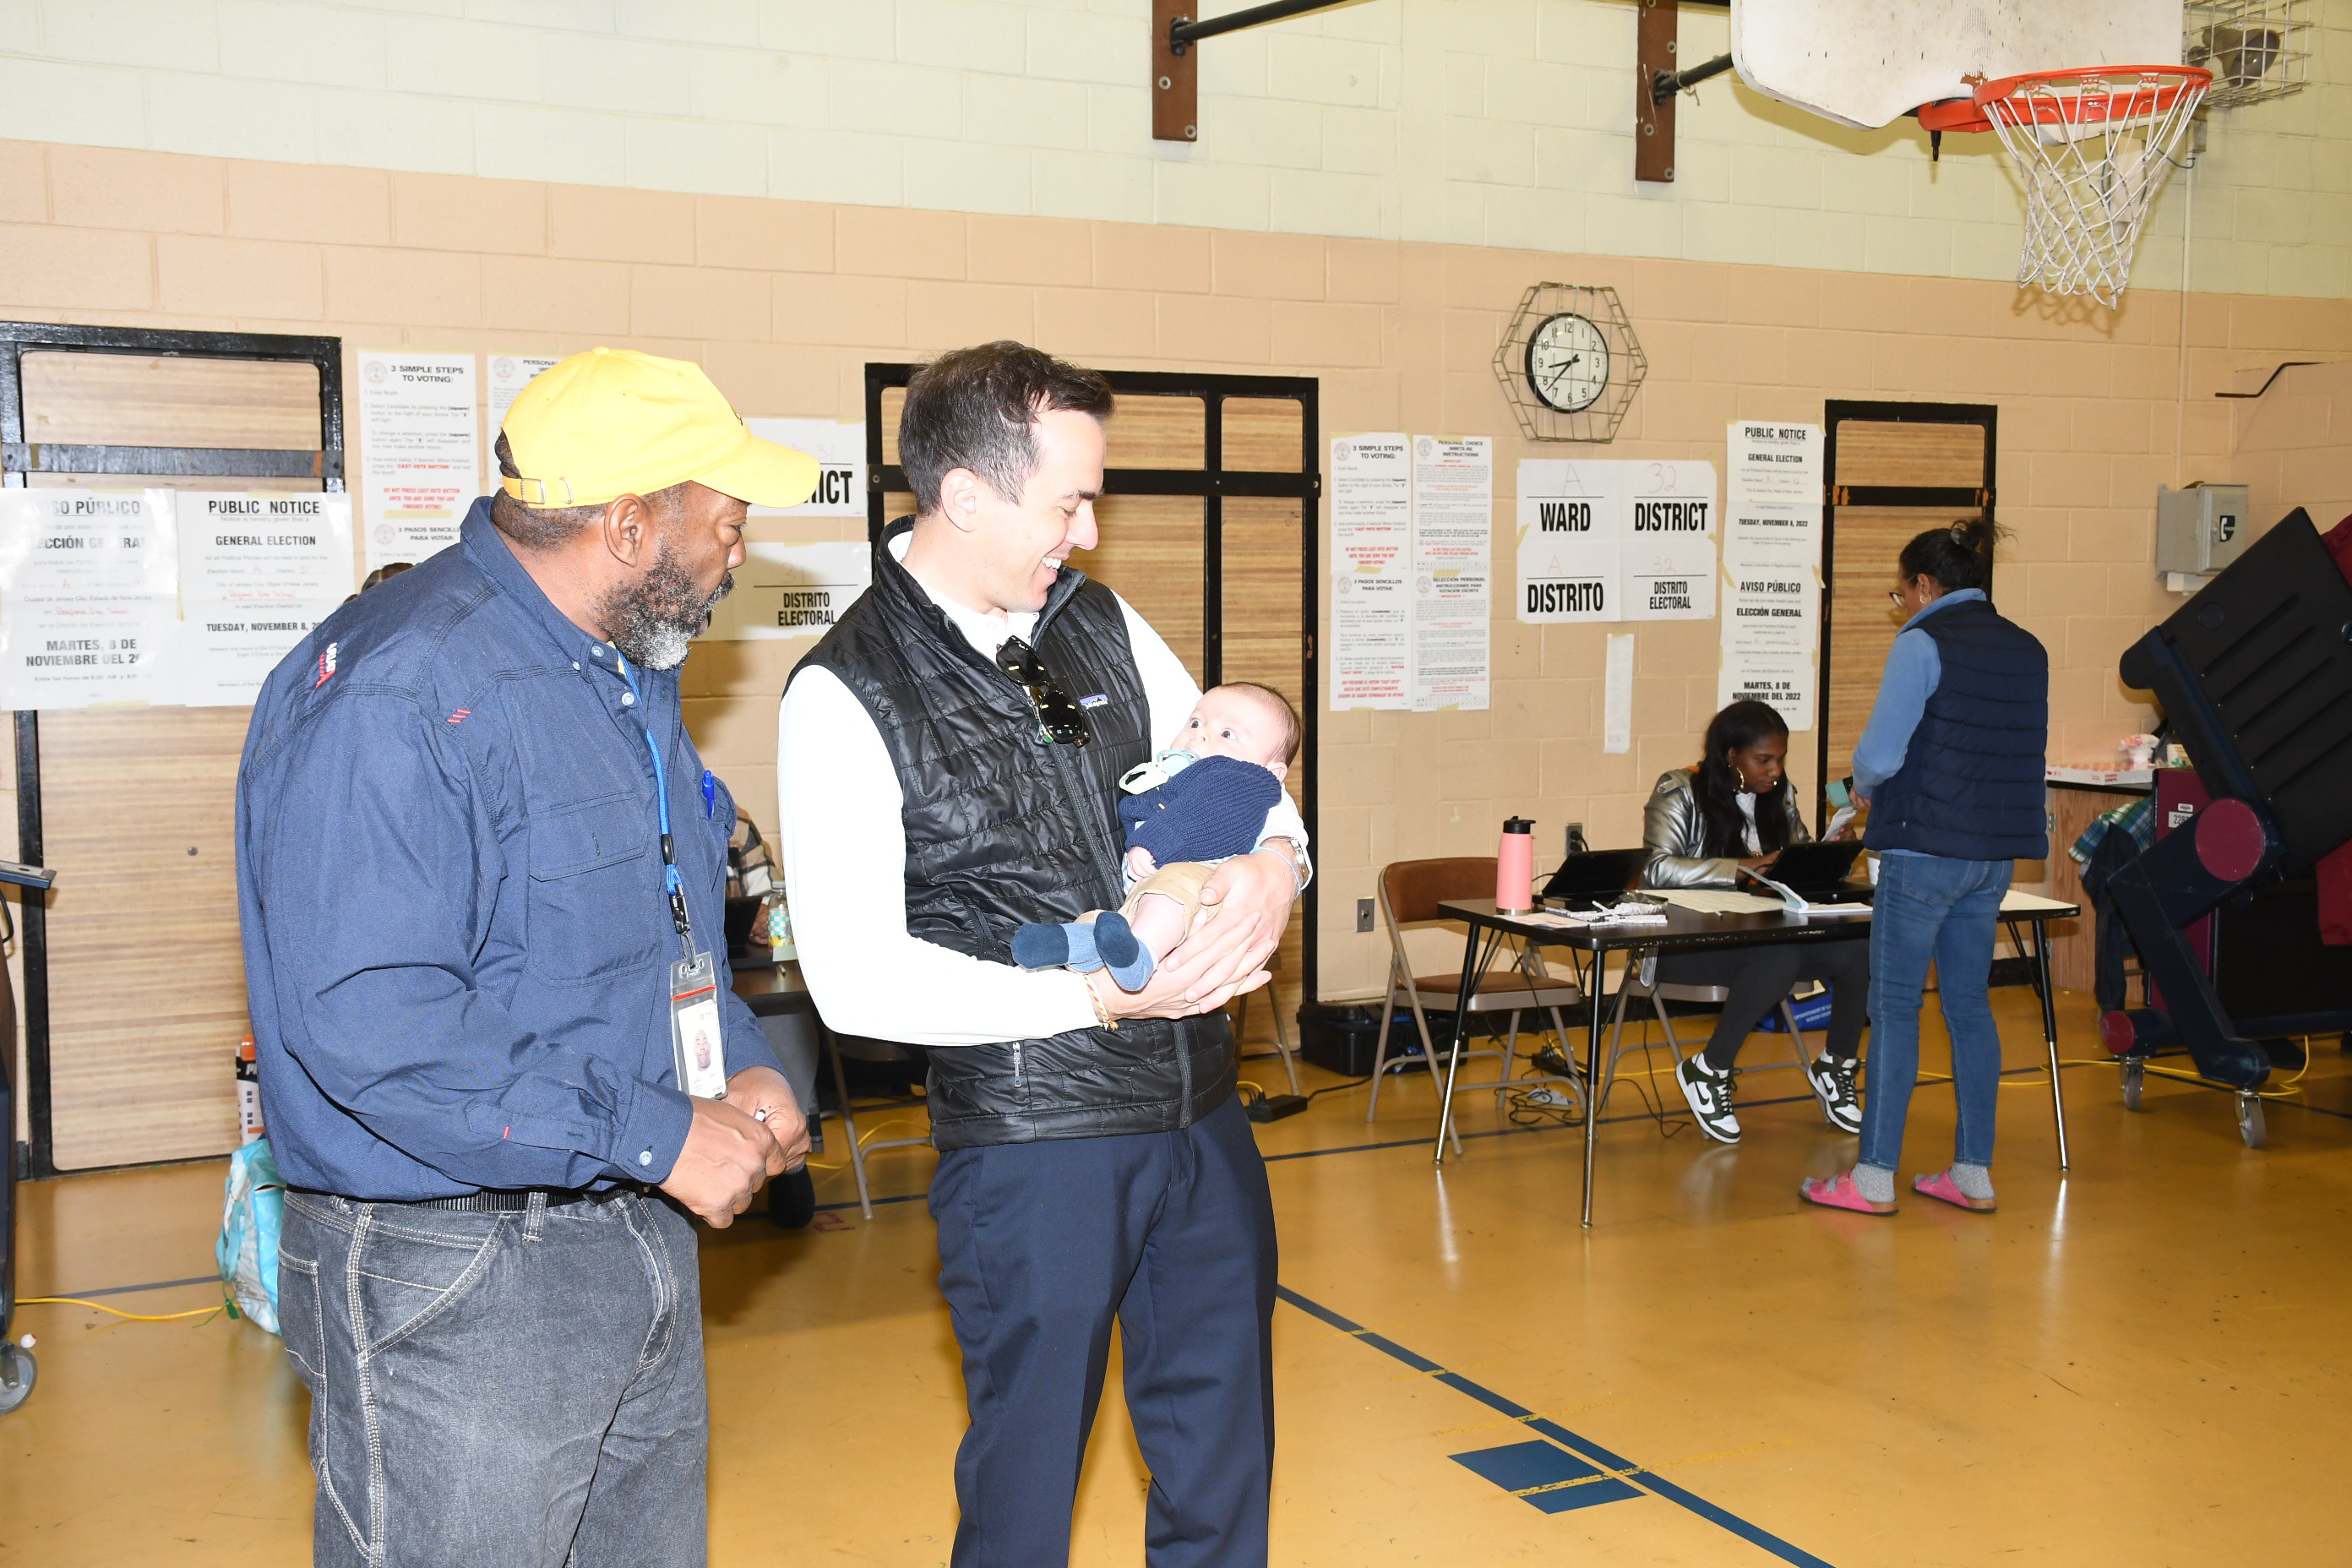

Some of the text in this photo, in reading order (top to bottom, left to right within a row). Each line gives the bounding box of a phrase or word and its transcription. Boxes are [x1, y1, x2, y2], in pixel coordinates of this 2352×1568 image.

[1564, 322, 1572, 334] 12
[1581, 328, 1585, 339] 1
[1540, 340, 1549, 351] 10
[1592, 340, 1598, 351] 2
[1538, 357, 1544, 368] 9
[1594, 357, 1600, 368] 3
[400, 365, 433, 373] SIMPLE
[435, 366, 464, 374] STEPS
[1543, 375, 1549, 386] 8
[1591, 374, 1597, 385] 4
[1553, 387, 1559, 398] 7
[1567, 392, 1573, 403] 6
[1582, 387, 1587, 398] 5
[1745, 427, 1806, 439] PUBLIC NOTICE
[1747, 453, 1803, 463] GENERAL ELECTION
[1563, 463, 1586, 497] A
[1647, 462, 1678, 495] 32
[76, 497, 140, 515] PÚBLICO
[208, 500, 320, 514] PUBLIC NOTICE
[1539, 503, 1591, 532] WARD
[1634, 502, 1708, 531] DISTRICT
[1738, 518, 1761, 526] TUESDAY,
[215, 536, 316, 546] GENERAL ELECTION
[1547, 555, 1563, 576] A
[1652, 555, 1678, 575] 32
[1653, 580, 1688, 595] DISTRITO
[1740, 579, 1801, 593] AVISO PÚBLICO
[783, 591, 830, 608] DISTRITO
[1527, 582, 1603, 613] DISTRITO
[1649, 596, 1691, 610] ELECTORAL
[777, 609, 836, 627] ELECTORAL
[1736, 607, 1802, 618] ELECCIÓN GENERAL
[206, 623, 248, 633] TUESDAY,
[250, 622, 298, 631] NOVEMBER
[300, 622, 309, 632] 8,
[46, 640, 104, 652] MARTES,
[121, 639, 137, 650] DE
[25, 654, 98, 667] NOVIEMBRE
[102, 653, 125, 664] DEL
[1744, 681, 1774, 691] MARTES,
[1771, 692, 1783, 700] DEL
